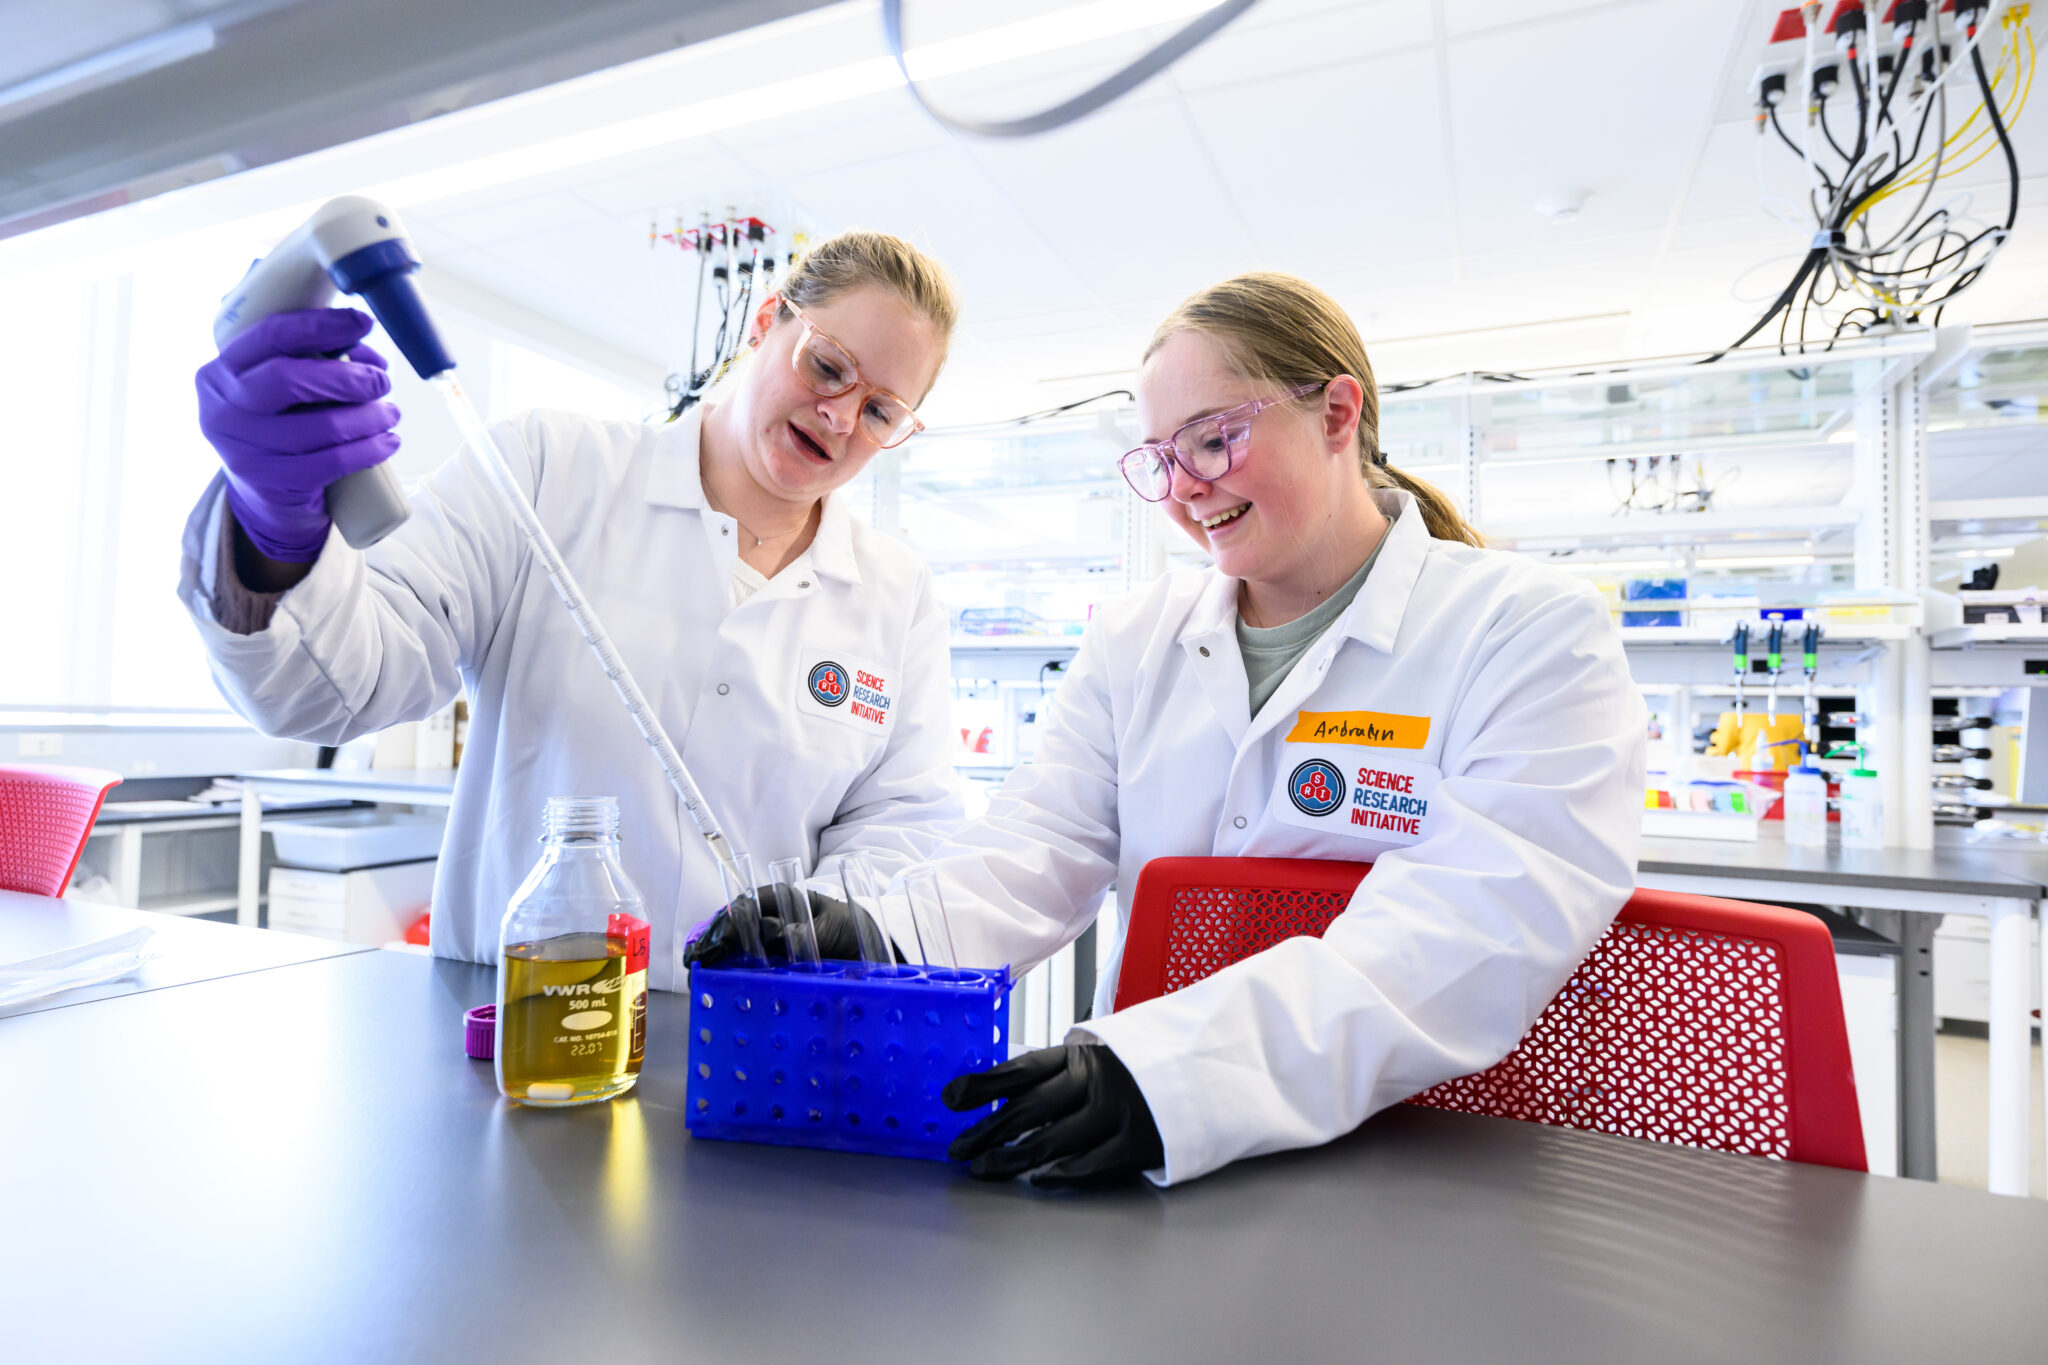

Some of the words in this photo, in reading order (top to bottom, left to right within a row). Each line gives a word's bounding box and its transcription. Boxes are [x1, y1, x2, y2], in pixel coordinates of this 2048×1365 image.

[856, 669, 885, 692] SCIENCE
[853, 685, 891, 709] RESEARCH
[850, 701, 886, 724] INITIATIVE
[1314, 774, 1322, 784] S
[1357, 767, 1414, 794] SCIENCE
[1353, 787, 1428, 816] RESEARCH
[1351, 808, 1421, 835] INITIATIVE
[543, 984, 590, 996] VWR
[568, 999, 589, 1010] 500
[591, 997, 608, 1008] mL
